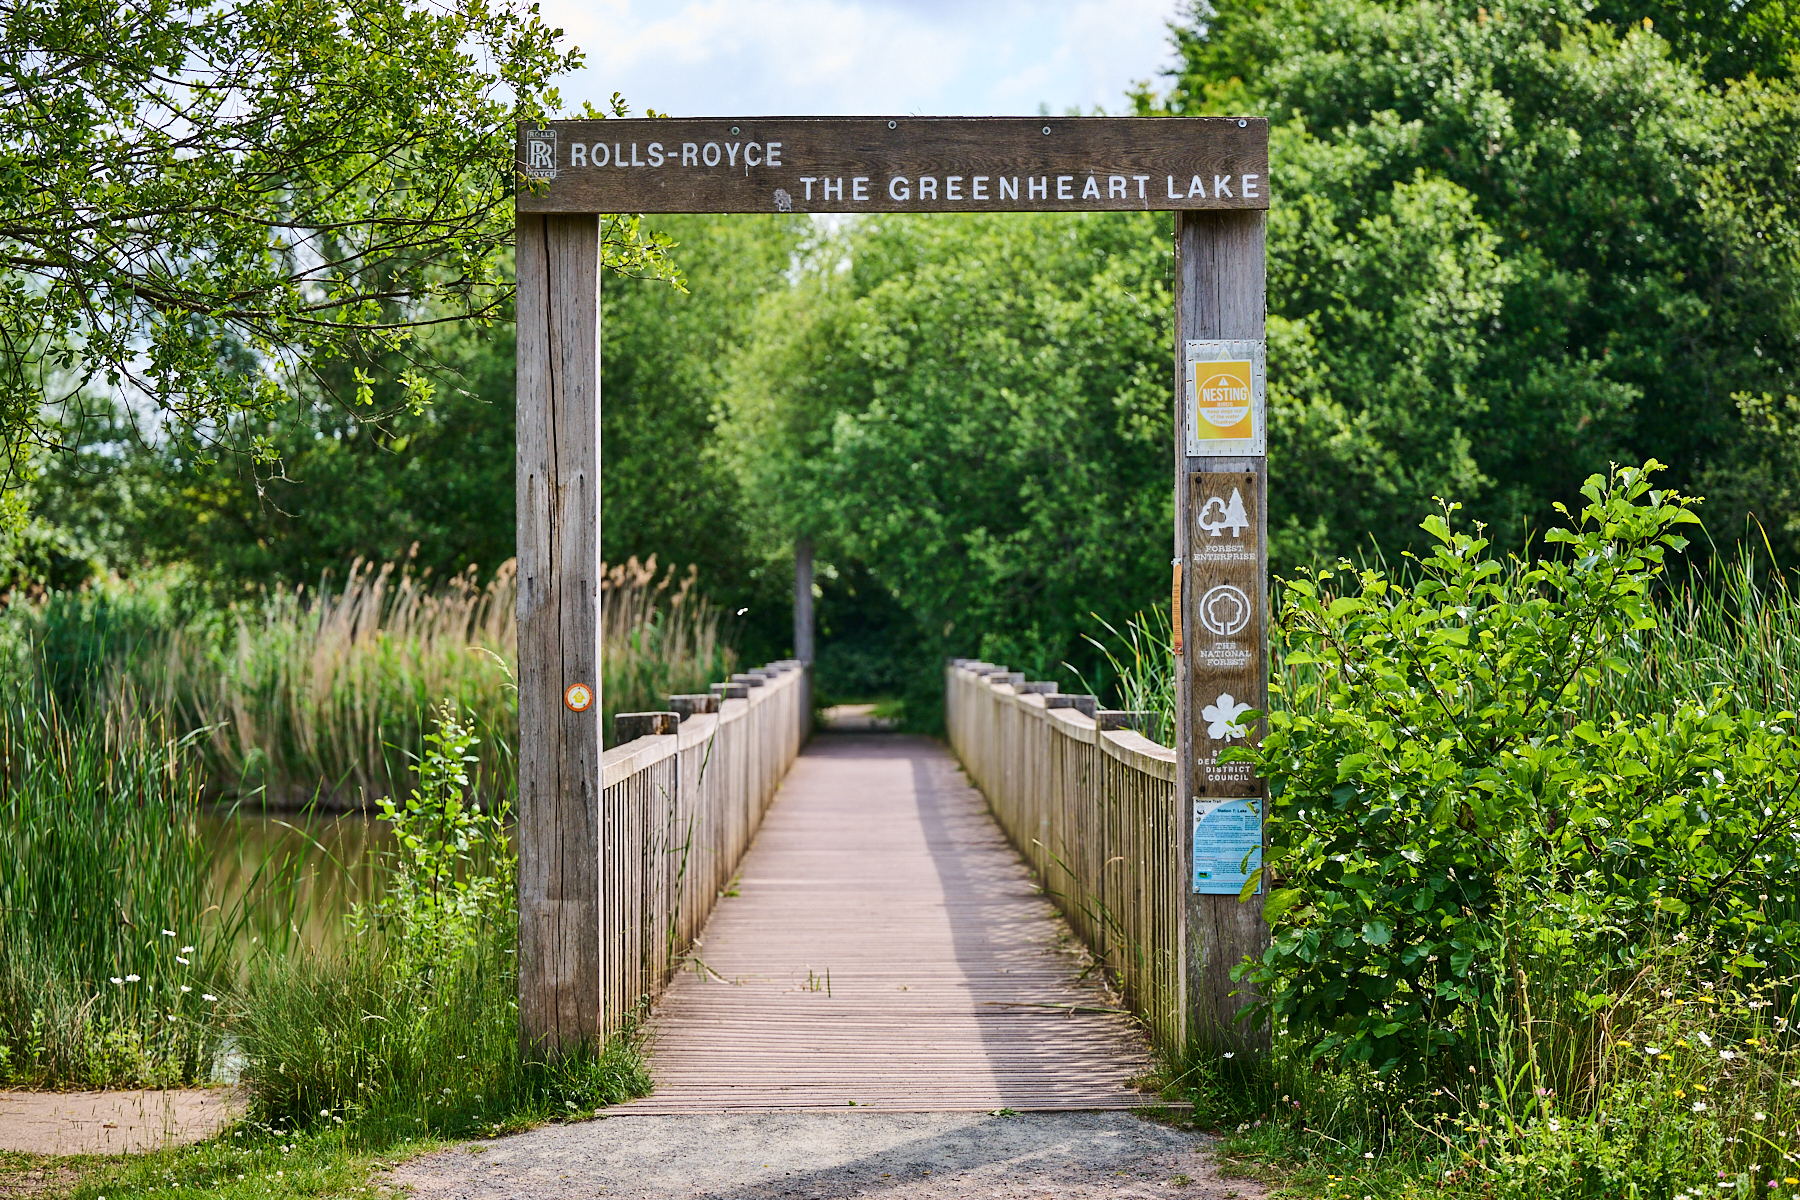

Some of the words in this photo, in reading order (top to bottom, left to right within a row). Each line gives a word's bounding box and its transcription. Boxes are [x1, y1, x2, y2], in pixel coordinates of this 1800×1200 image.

[571, 142, 782, 167] ROLLS-ROYCE
[800, 176, 869, 201] THE
[888, 174, 1150, 201] GREENHEART
[1166, 173, 1260, 200] LAKE
[1203, 388, 1247, 401] NESTING
[1205, 545, 1244, 553] FOREST
[1193, 553, 1256, 561] ENTERPRISE
[1215, 642, 1236, 650] THE
[1200, 650, 1252, 658] NATIONAL
[1206, 658, 1246, 666] FOREST
